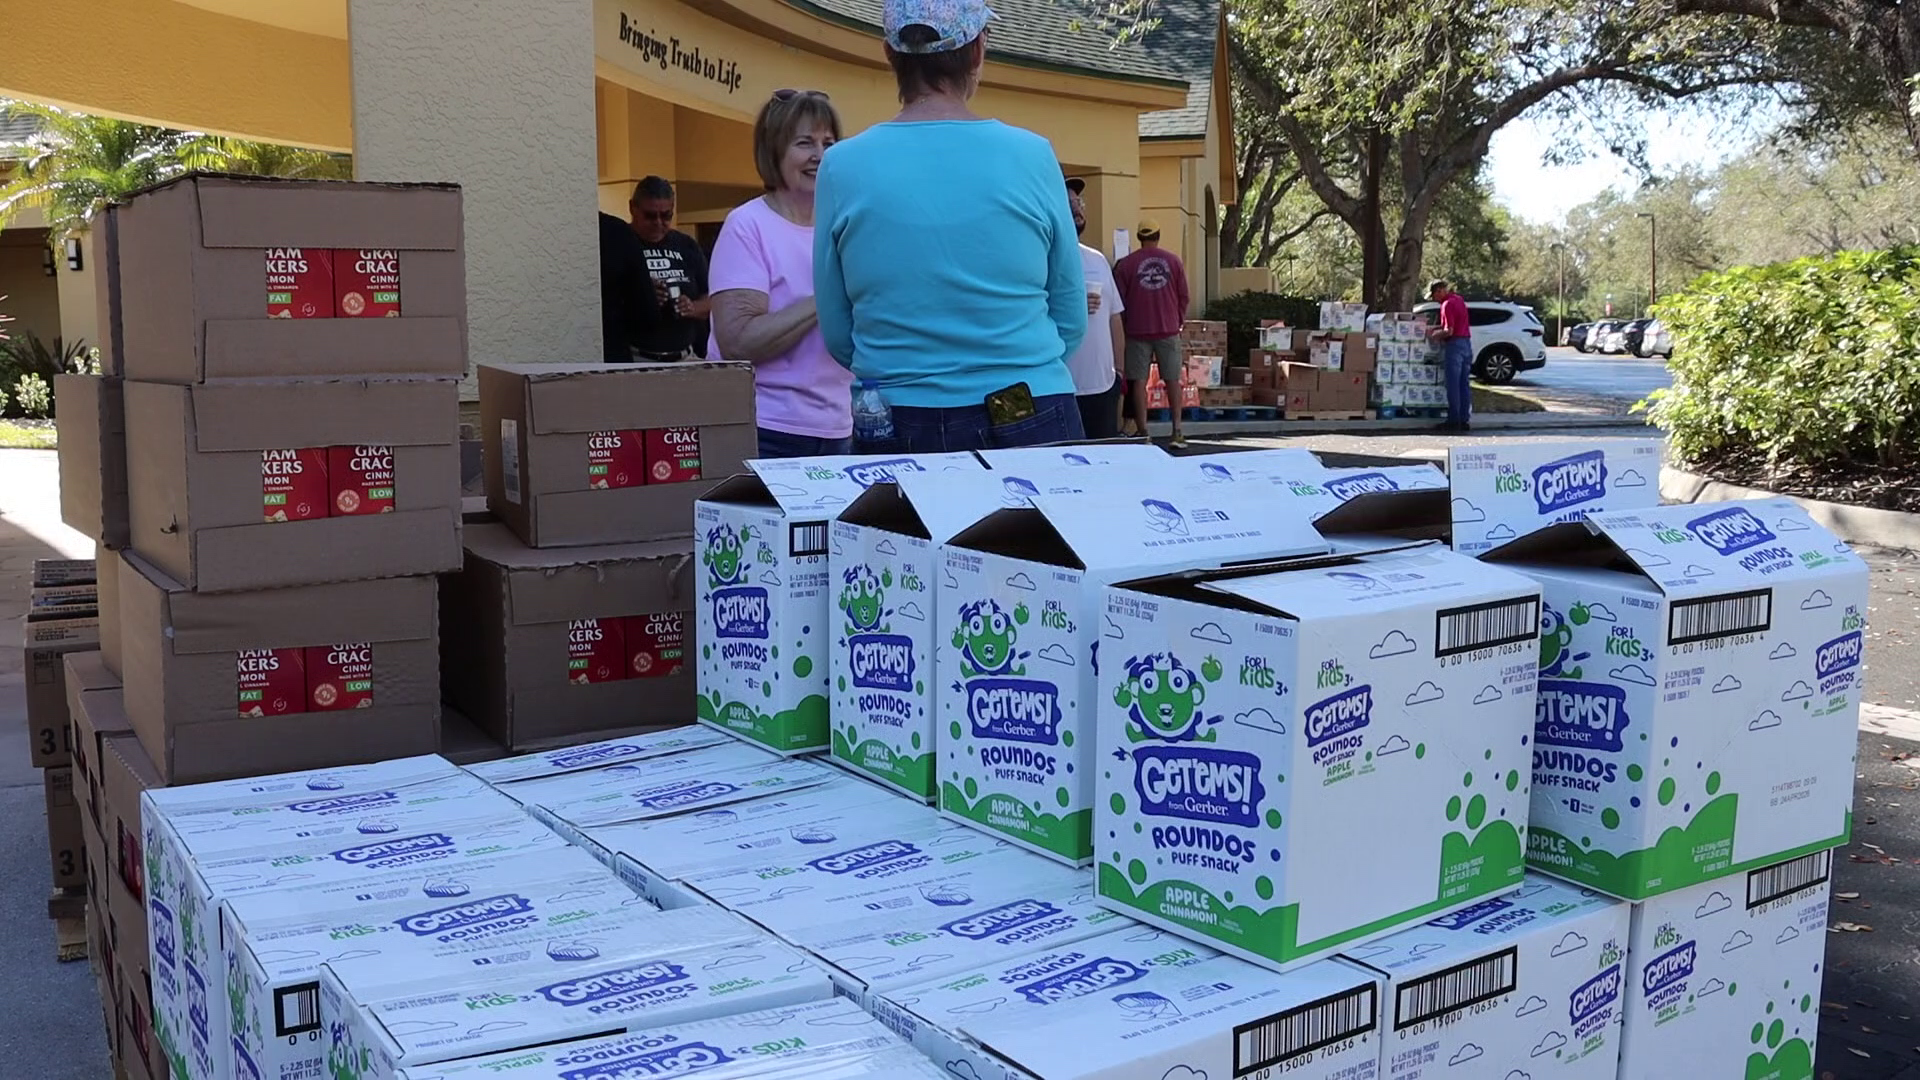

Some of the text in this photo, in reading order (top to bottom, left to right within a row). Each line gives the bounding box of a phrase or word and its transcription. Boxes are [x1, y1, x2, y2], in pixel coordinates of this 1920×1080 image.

[619, 12, 742, 94] Bringing Truth to Life
[355, 260, 398, 274] CRAC
[269, 294, 286, 302] FAT
[350, 457, 392, 471] CRAC
[264, 496, 281, 504] FAT
[373, 490, 392, 498] LOW
[1672, 645, 1678, 656] 0
[1683, 642, 1694, 654] 00
[1700, 638, 1725, 652] 15000
[1730, 634, 1754, 647] 70636
[328, 650, 370, 664] CRAC
[1440, 658, 1446, 668] 0
[1452, 655, 1462, 666] 00
[1468, 649, 1493, 664] 15000
[1498, 644, 1522, 657] 70636
[350, 682, 372, 690] LOW
[240, 691, 258, 700] FAT
[40, 728, 56, 756] 3
[1548, 725, 1592, 742] Gerber
[981, 746, 1056, 776] ROUNDOS
[995, 769, 1016, 780] PUFF
[1533, 773, 1560, 786] PUFF
[991, 800, 1024, 818] APPLE
[1185, 797, 1228, 816] Gerber
[1152, 825, 1256, 863] ROUNDOS
[59, 849, 76, 877] 3
[1172, 851, 1199, 866] PUFF
[1166, 886, 1210, 910] APPLE
[1160, 903, 1218, 926] CINNAMON!
[1400, 1029, 1406, 1040] 0
[1413, 1022, 1425, 1036] 00
[1432, 1010, 1463, 1030] 15000
[1470, 999, 1498, 1017] 70636
[289, 1034, 297, 1046] 0
[1278, 1053, 1313, 1074] 15000
[1321, 1039, 1354, 1060] 70636
[1362, 1034, 1368, 1044] 4
